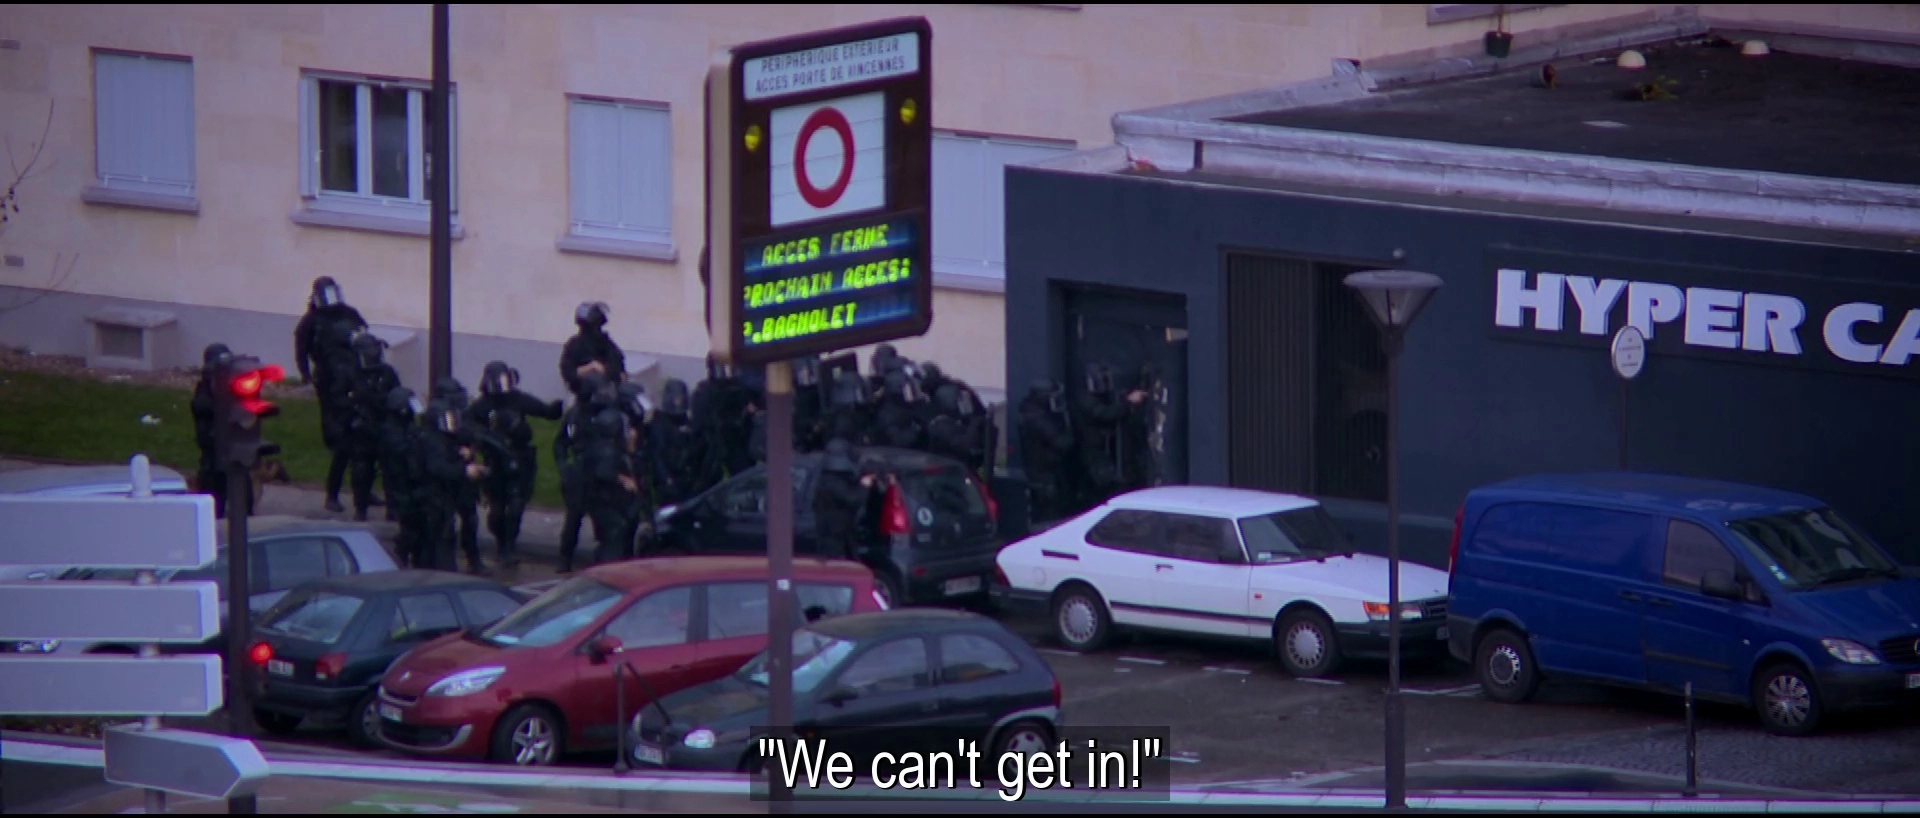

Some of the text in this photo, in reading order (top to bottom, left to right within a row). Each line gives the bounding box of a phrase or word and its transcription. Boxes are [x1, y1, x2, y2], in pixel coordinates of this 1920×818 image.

[755, 55, 905, 93] ACCES PORTE DE VINCENNES
[761, 223, 889, 268] ACCES FERME
[842, 257, 911, 290] ACCES:
[1495, 268, 1806, 355] HYPER
